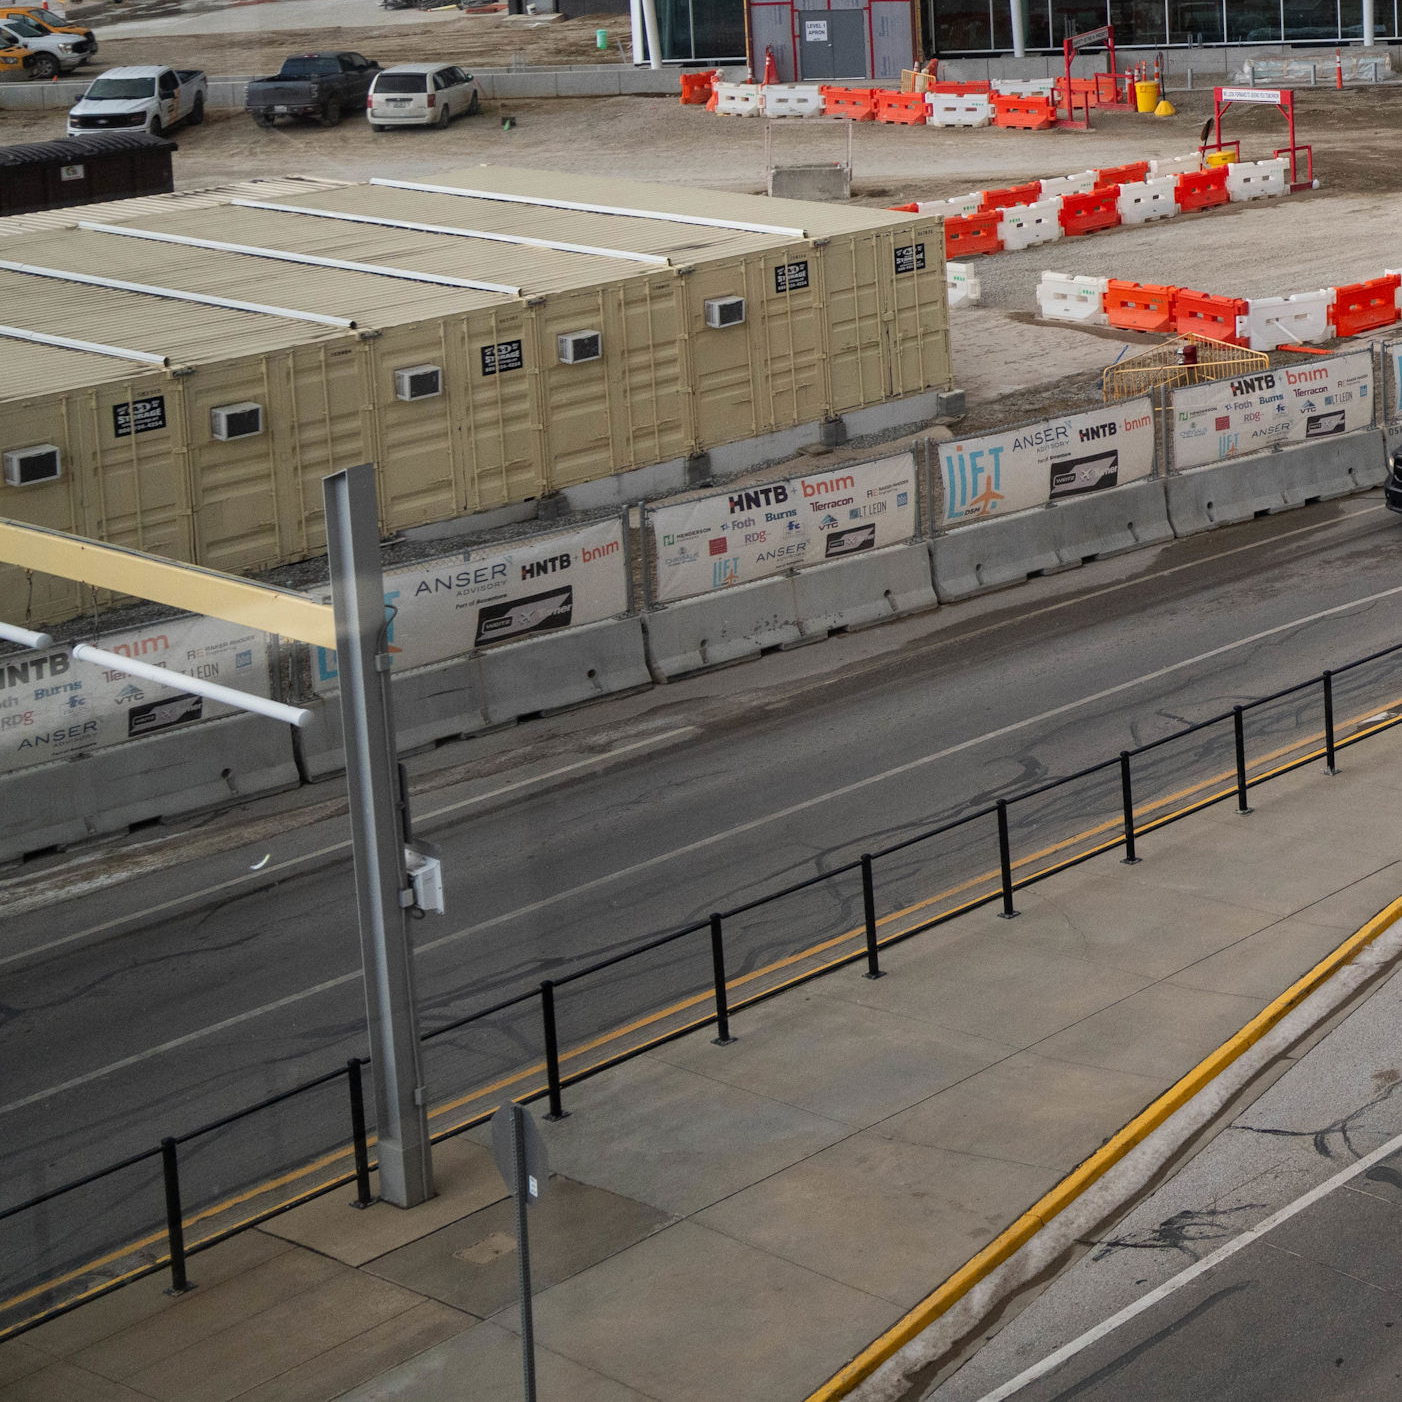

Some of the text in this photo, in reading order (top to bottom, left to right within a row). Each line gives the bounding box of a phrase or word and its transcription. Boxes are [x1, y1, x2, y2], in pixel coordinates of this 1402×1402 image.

[777, 271, 807, 283] STRAGE
[485, 350, 520, 364] STRAGE
[1230, 374, 1276, 397] HNTB
[1285, 367, 1329, 385] bnim
[1258, 393, 1284, 406] Burns
[1293, 386, 1328, 398] Terracon
[1233, 400, 1253, 411] Foth
[1300, 406, 1317, 414] VTC
[117, 407, 162, 425] STRAGE
[1079, 415, 1152, 443] HNTB bnim
[1251, 422, 1291, 439] ANSER
[1012, 425, 1069, 453] ANSER
[946, 445, 1004, 519] LIFT
[729, 484, 788, 514] HNTB
[801, 475, 855, 498] bnim
[810, 497, 854, 513] Terracon
[731, 516, 756, 531] Foth
[765, 508, 797, 523] Burns
[818, 521, 839, 531] VTC
[744, 530, 767, 544] RDg
[521, 552, 571, 581] HNTB
[582, 541, 620, 563] bnim
[756, 542, 807, 563] ANSER
[414, 563, 507, 597] ANSER
[456, 579, 508, 597] ADVISORY
[191, 662, 219, 680] LEON
[34, 680, 83, 701] Burns
[114, 692, 146, 705] VTC
[1, 710, 35, 732] RDg
[18, 720, 98, 752] ANSER
